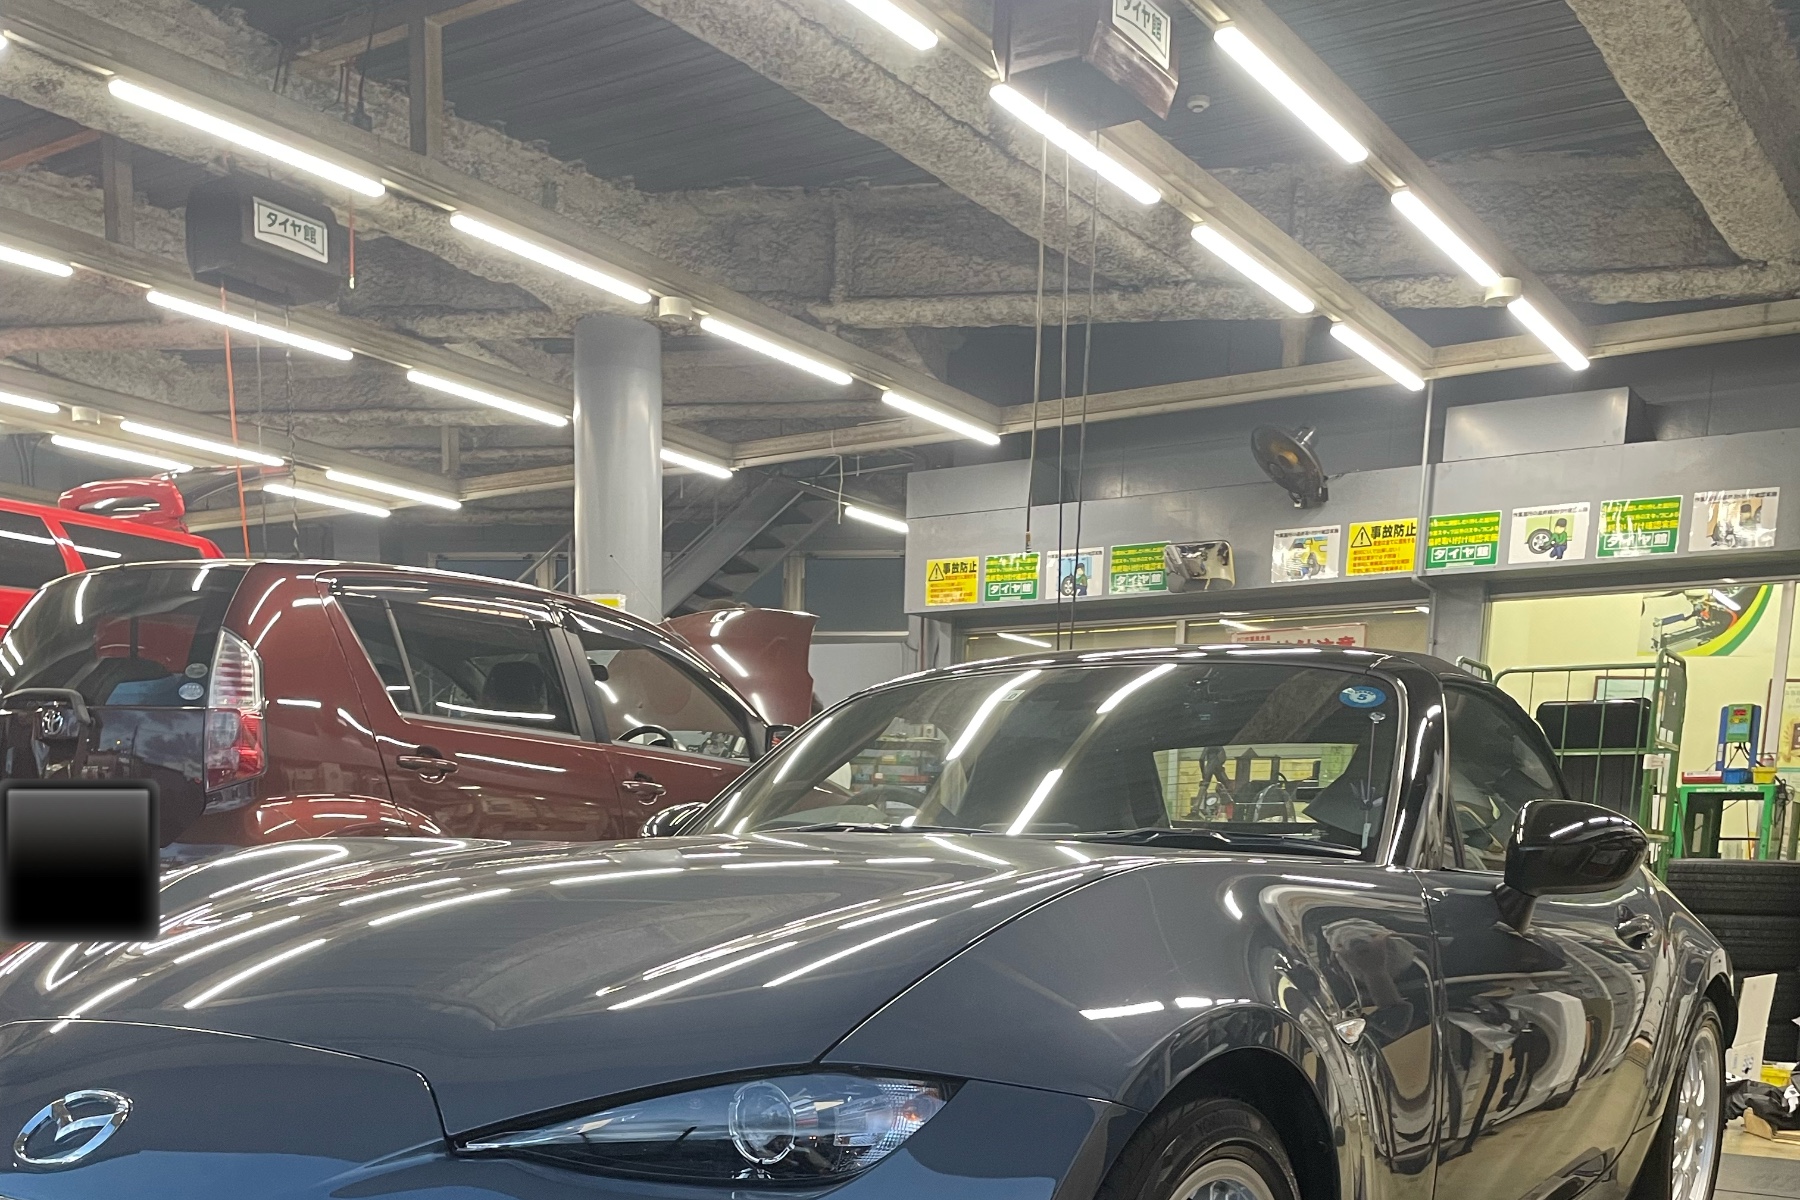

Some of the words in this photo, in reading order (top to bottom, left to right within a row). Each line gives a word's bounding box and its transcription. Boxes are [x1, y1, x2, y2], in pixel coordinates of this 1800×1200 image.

[266, 212, 317, 244] タイヤ館
[1371, 522, 1416, 539] 事故防止
[1433, 546, 1489, 560] タイヤ館
[943, 561, 977, 574] 事故防止
[990, 584, 1031, 594] タイヤ館
[1357, 693, 1368, 701] 5
